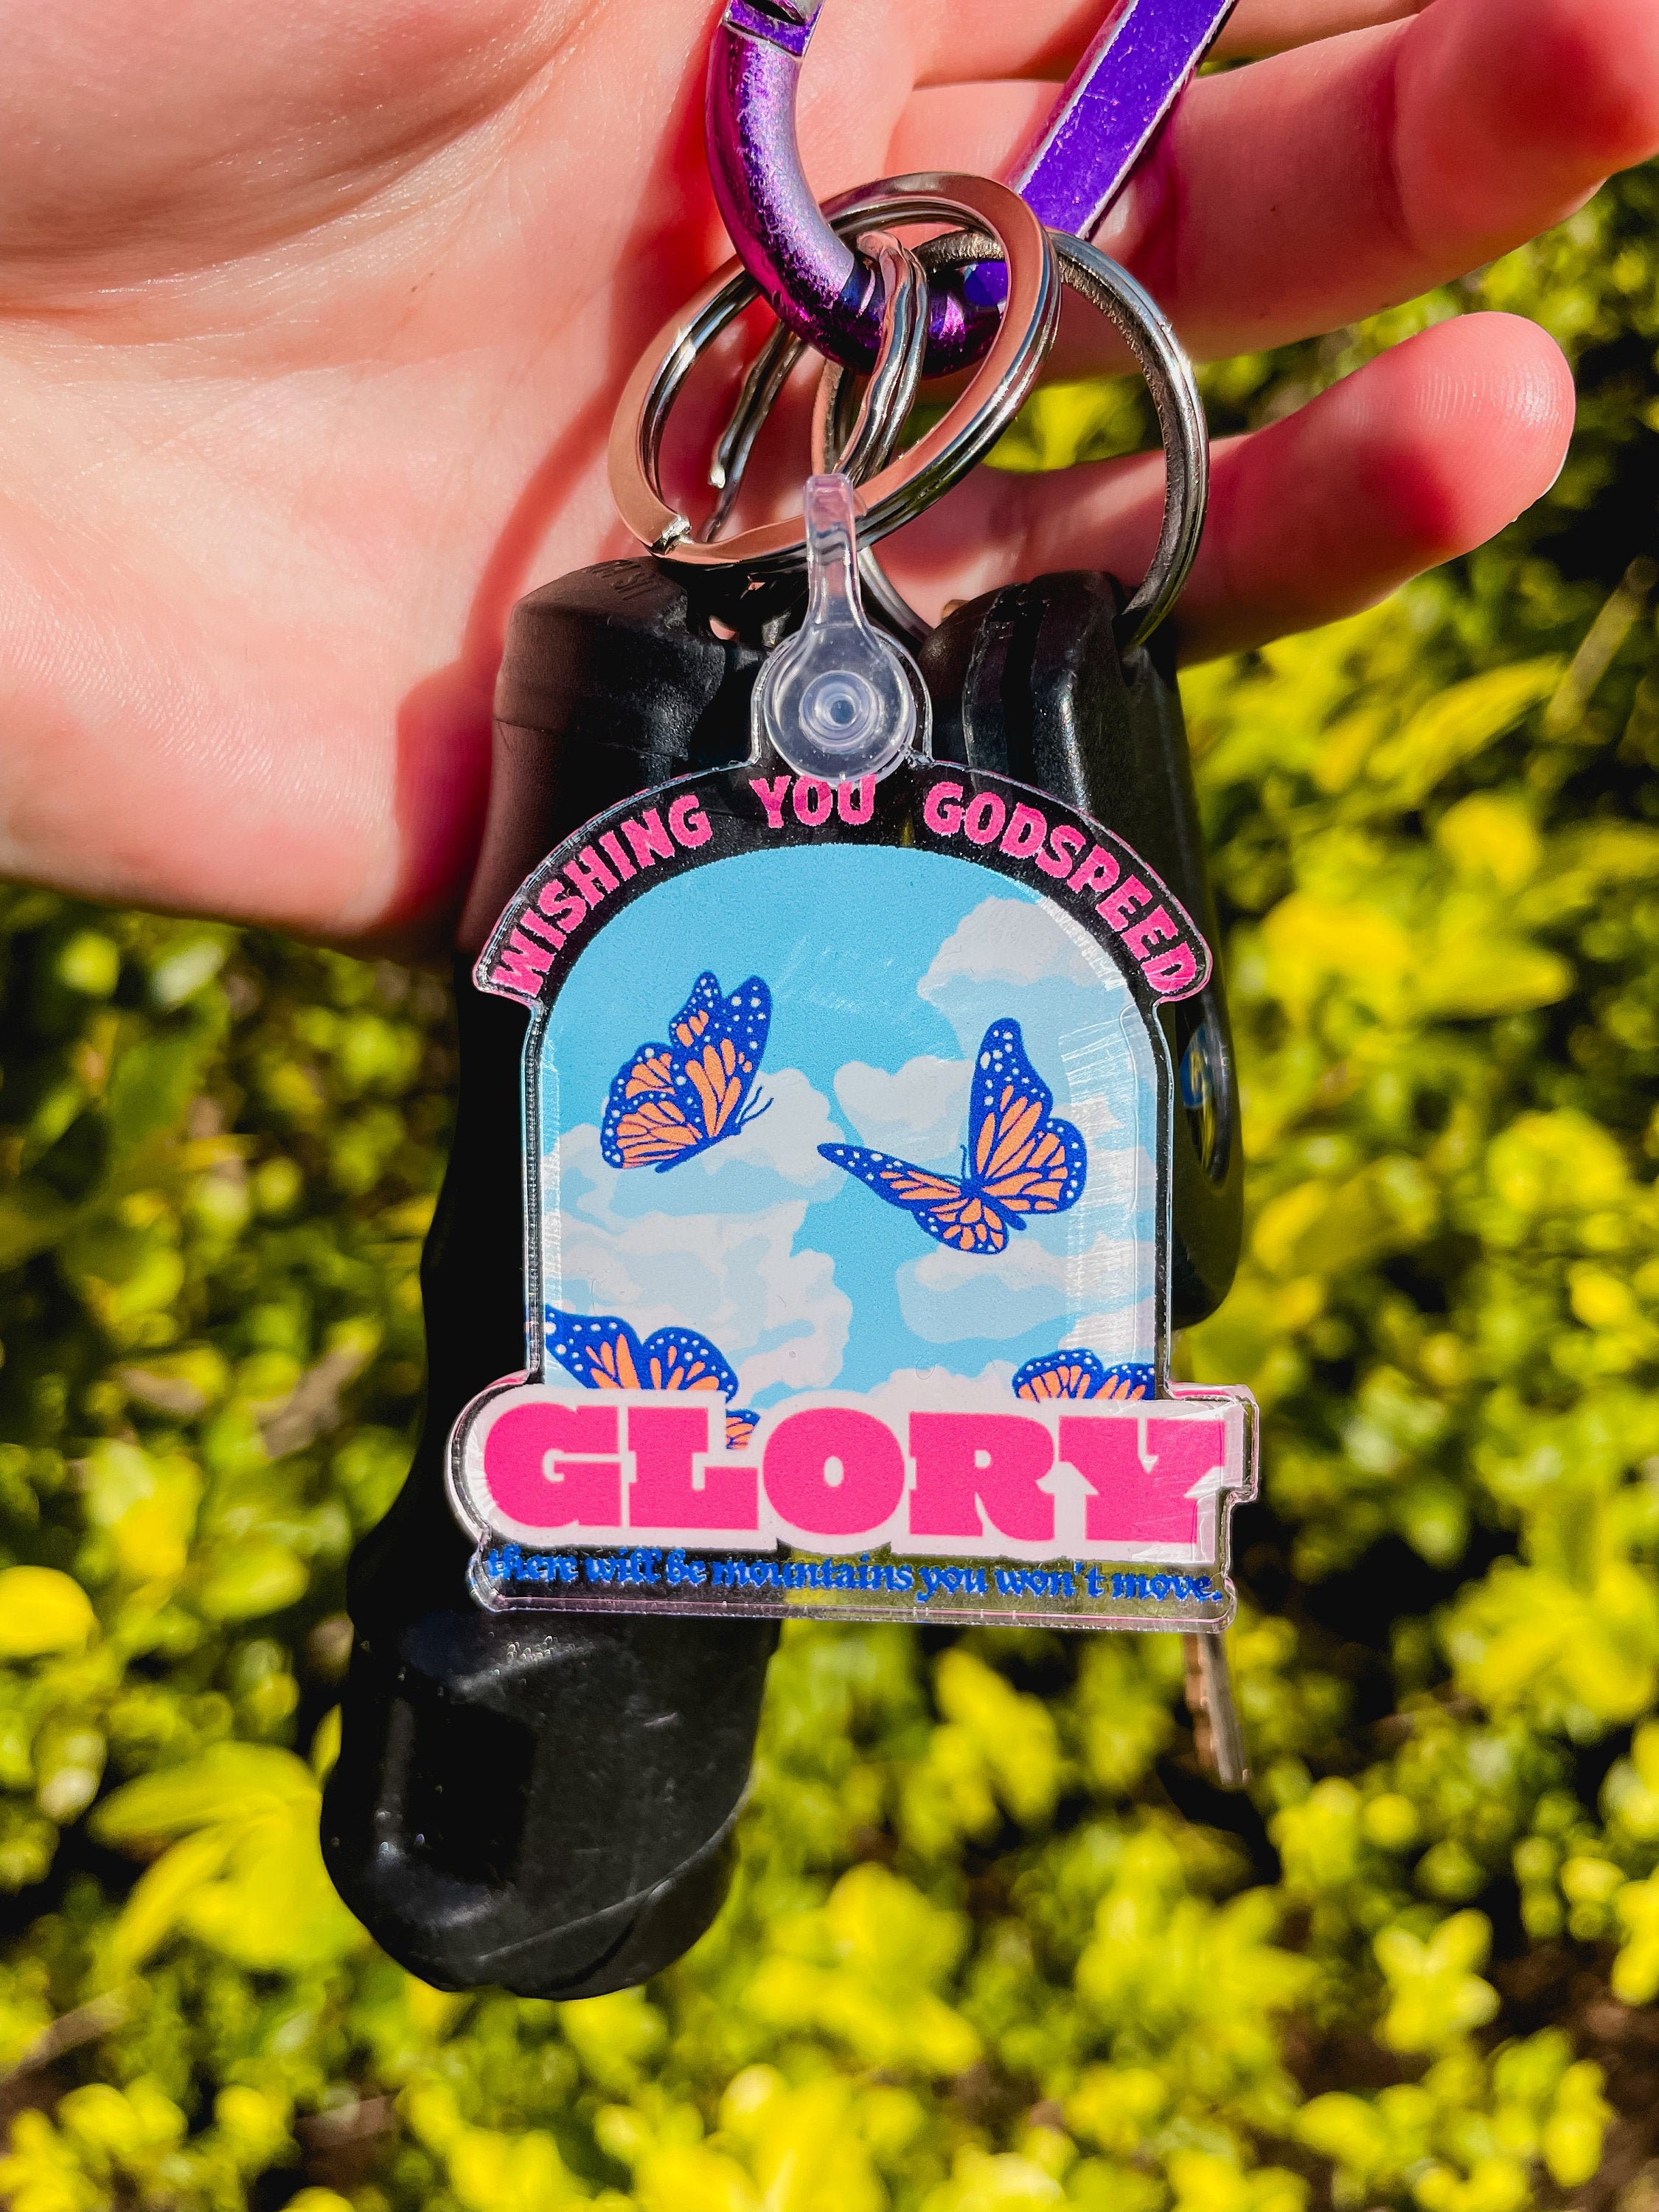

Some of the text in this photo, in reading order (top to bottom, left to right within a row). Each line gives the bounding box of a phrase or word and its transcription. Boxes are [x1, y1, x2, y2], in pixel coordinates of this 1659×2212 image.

[490, 773, 1197, 998] WISHING YOU GODSPEED
[484, 1402, 1225, 1543] GLORY
[486, 1543, 1223, 1603] there will be mountains you won't move.
